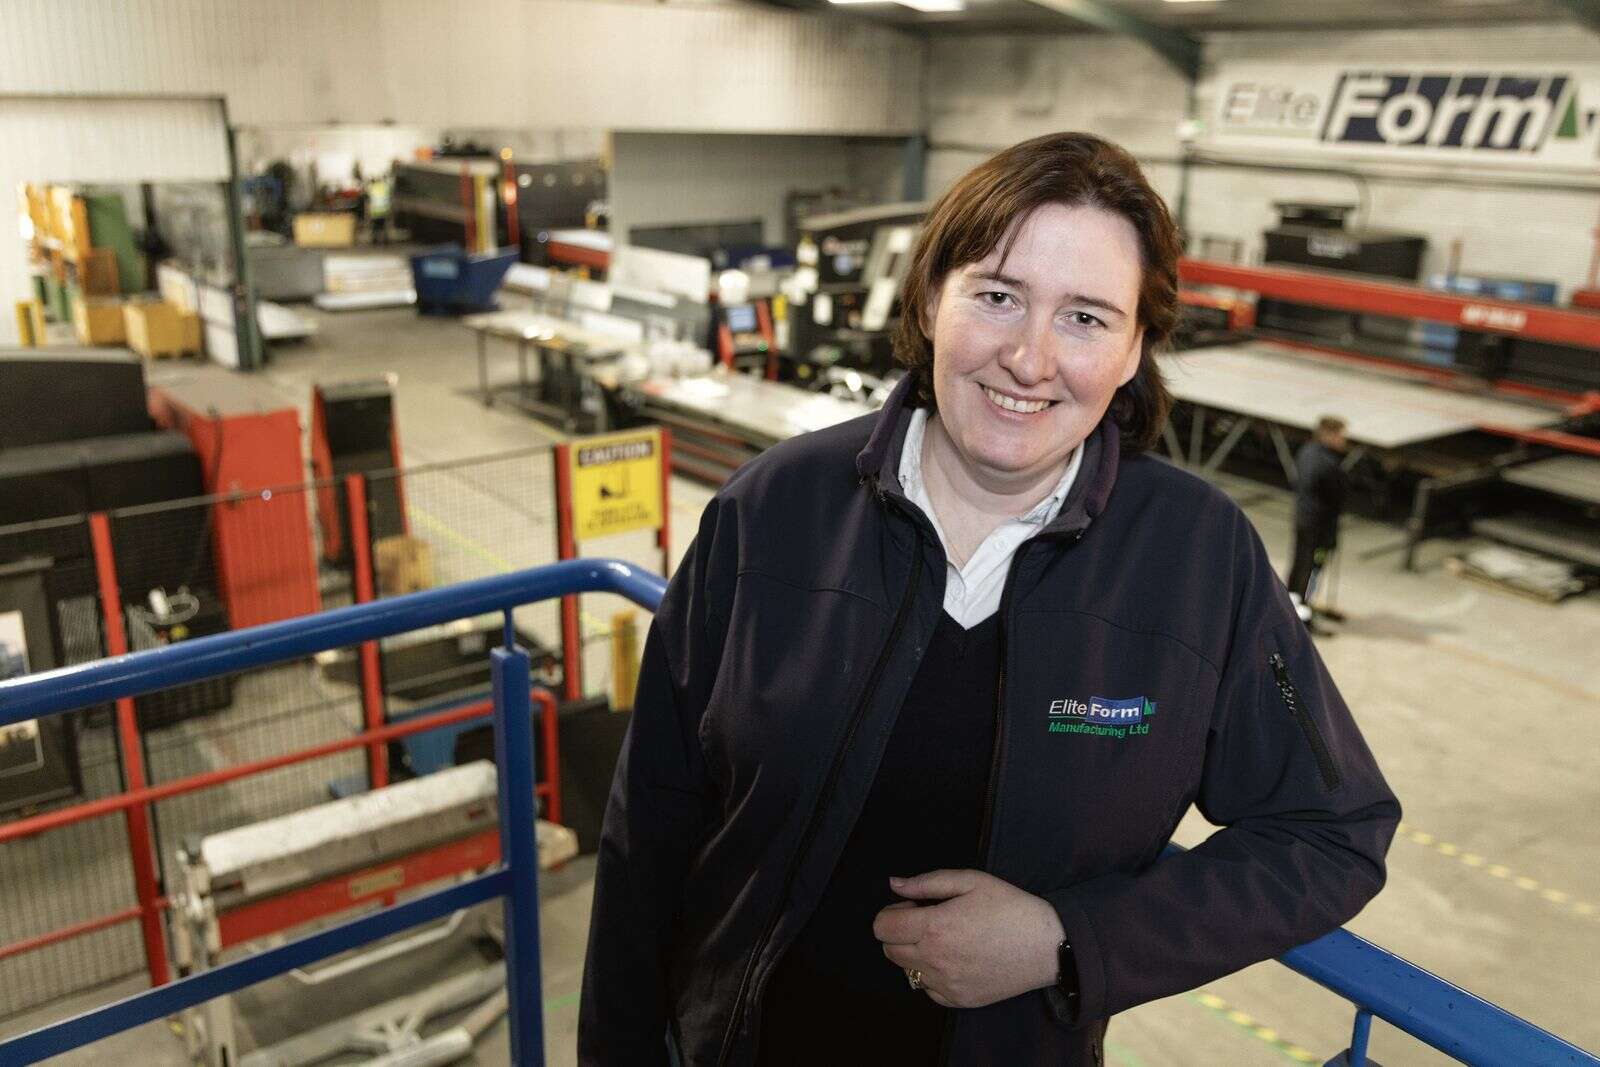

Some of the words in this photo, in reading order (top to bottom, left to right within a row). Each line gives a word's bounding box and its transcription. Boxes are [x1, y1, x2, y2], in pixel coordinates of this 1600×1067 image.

[1327, 77, 1551, 150] Form
[1049, 699, 1087, 715] Elite
[1090, 703, 1139, 718] Form
[1048, 721, 1125, 738] Manufacturing
[1129, 723, 1149, 735] Ltd
